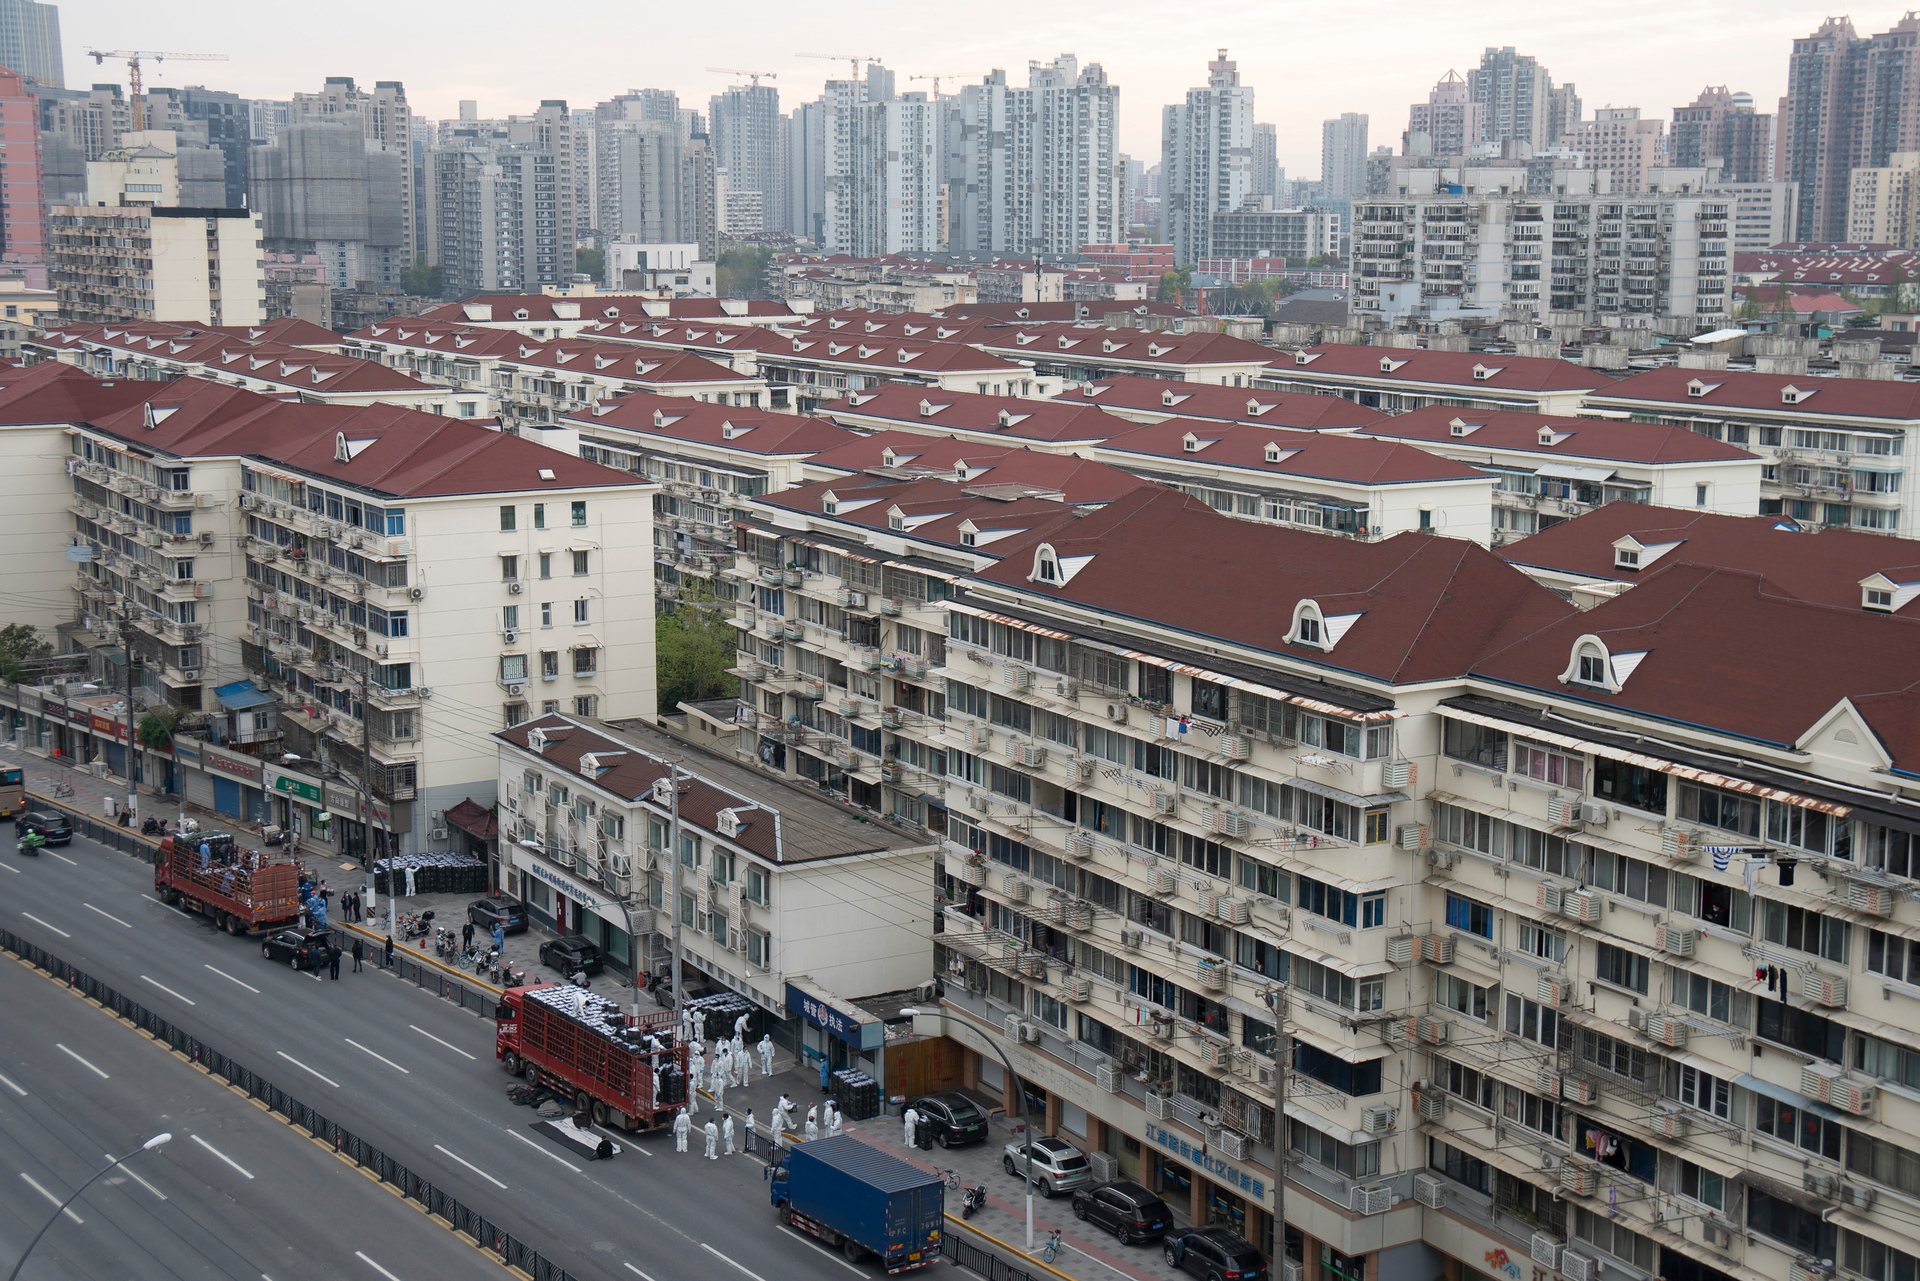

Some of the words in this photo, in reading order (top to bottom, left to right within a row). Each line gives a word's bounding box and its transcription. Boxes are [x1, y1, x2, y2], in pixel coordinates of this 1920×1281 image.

[803, 998, 817, 1018] 城管
[829, 1013, 843, 1033] 执法
[1145, 1121, 1265, 1200] 江浦路街道社区创新屋
